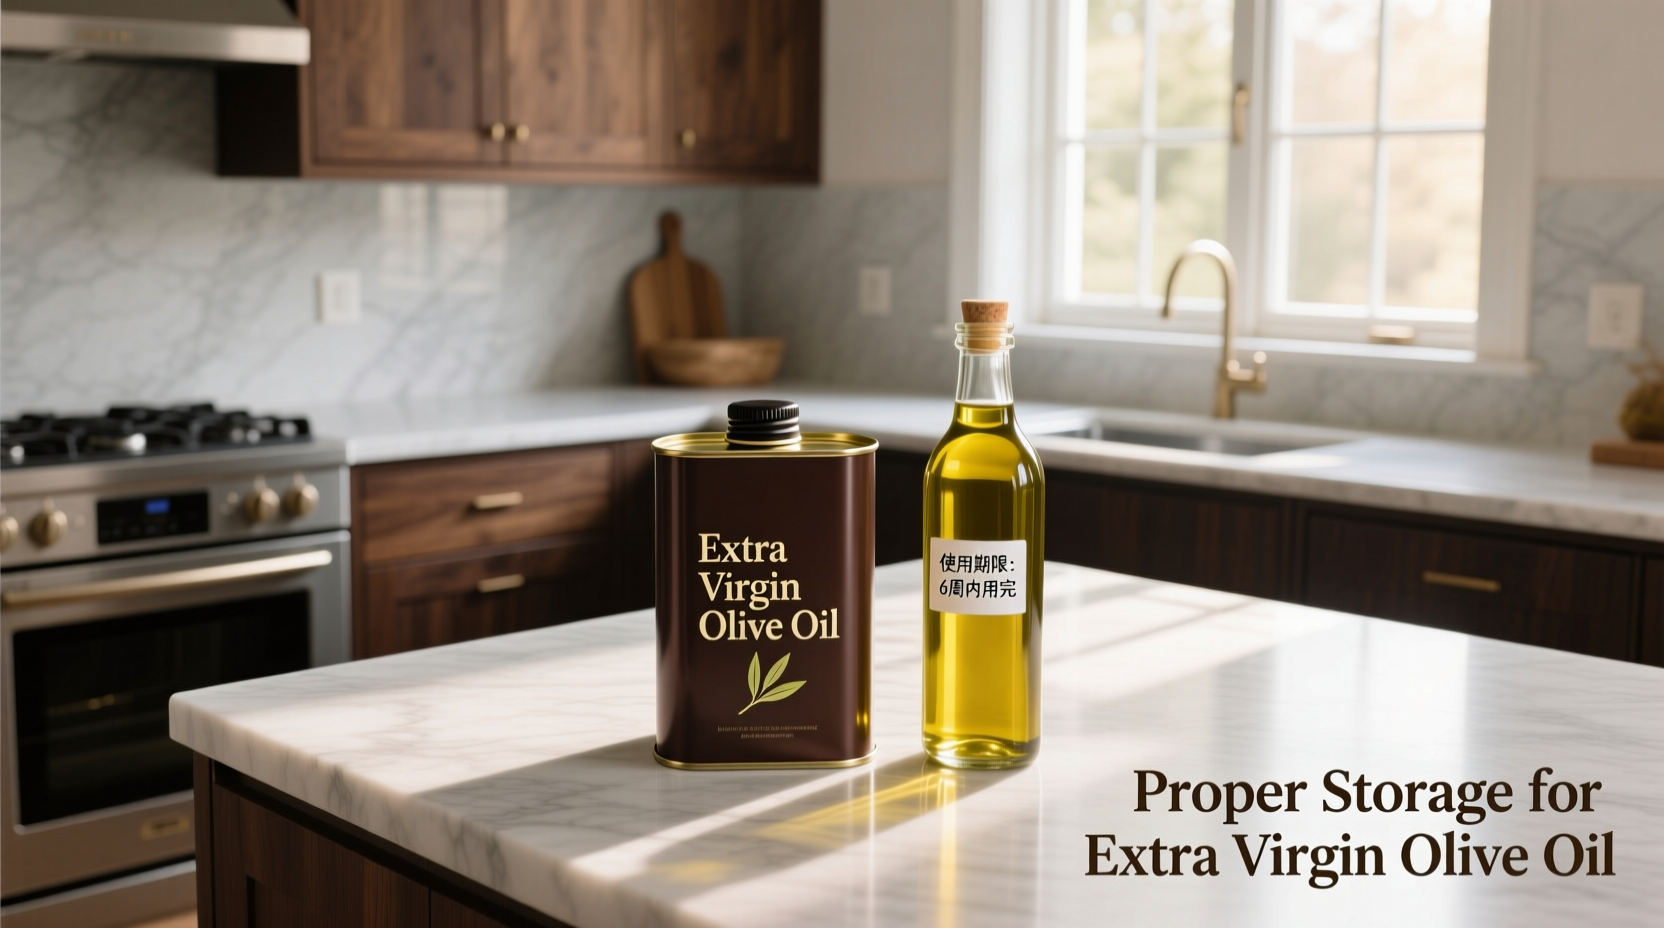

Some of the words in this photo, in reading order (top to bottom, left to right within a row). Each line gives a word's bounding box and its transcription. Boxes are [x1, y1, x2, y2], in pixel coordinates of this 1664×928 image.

[698, 533, 788, 563] Extra
[697, 571, 802, 611] Virgin
[698, 608, 783, 641] Olive
[791, 606, 841, 641] Oil
